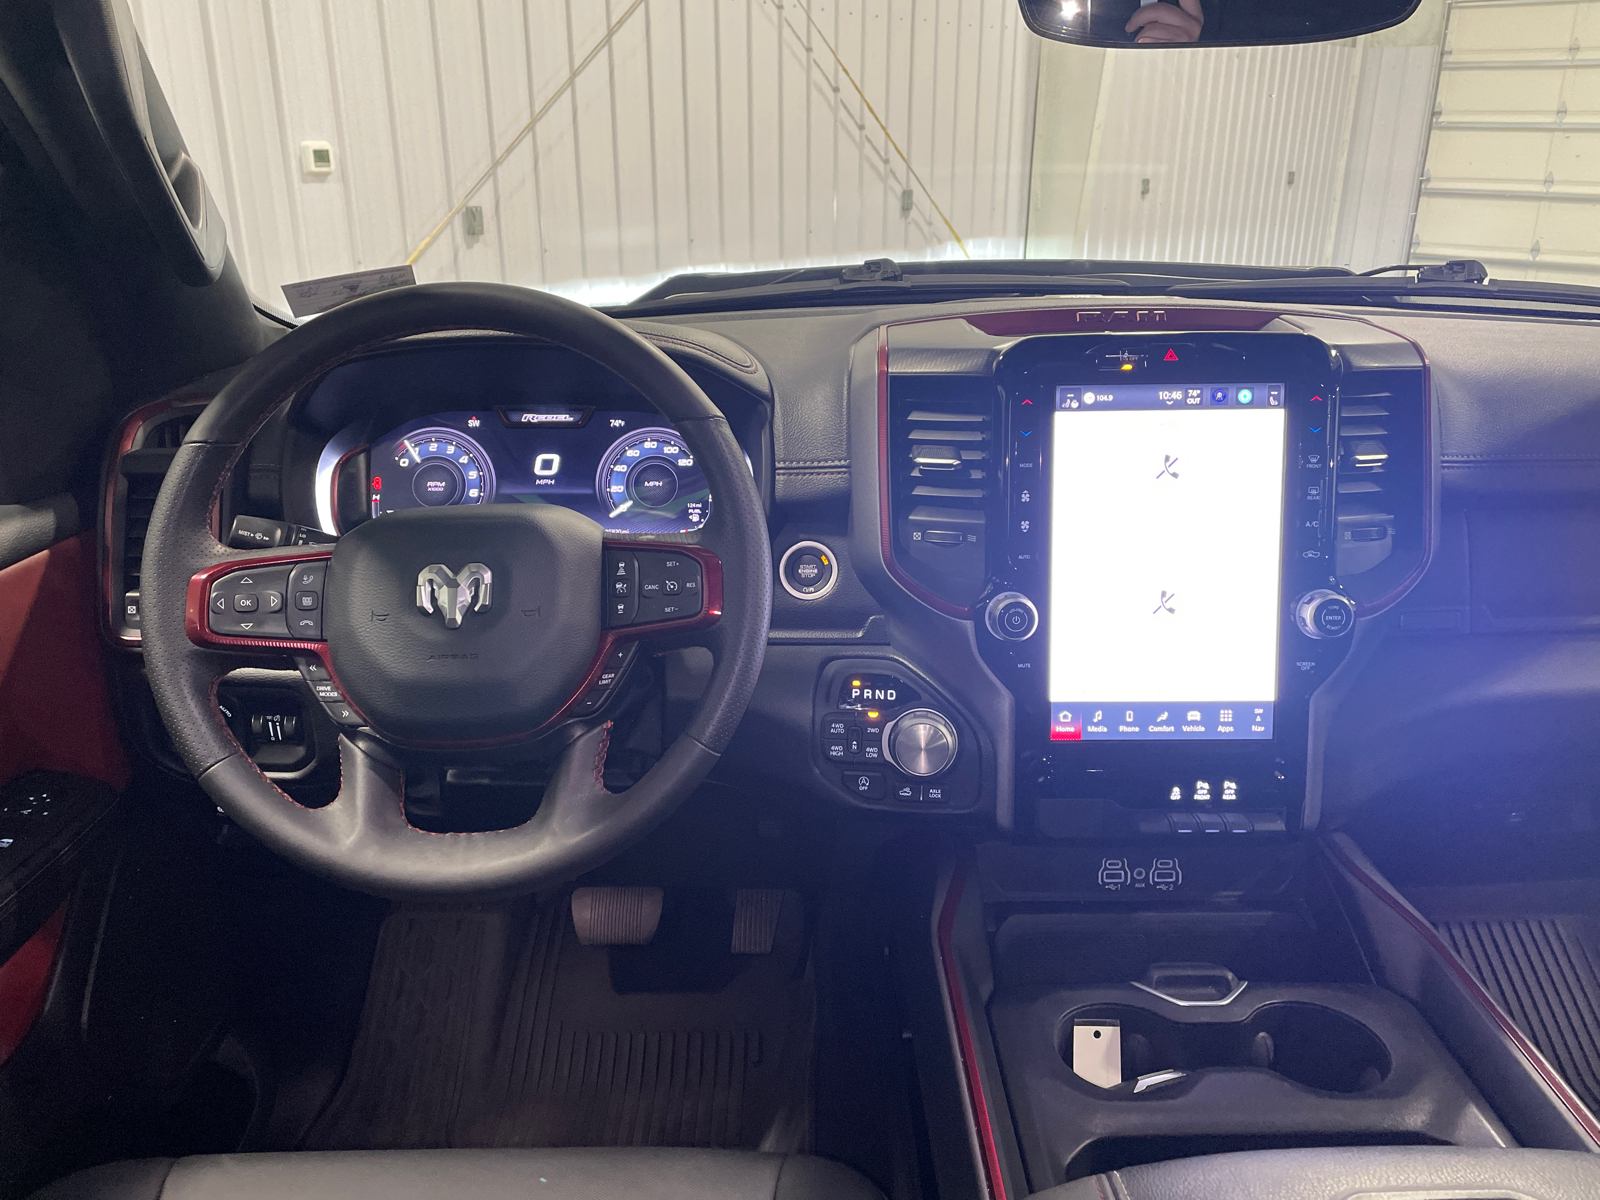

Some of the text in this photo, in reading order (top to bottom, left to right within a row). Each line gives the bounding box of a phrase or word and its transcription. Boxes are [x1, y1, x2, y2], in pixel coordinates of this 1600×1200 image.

[1096, 394, 1113, 402] 104.9
[1158, 390, 1183, 400] 10:46
[1186, 397, 1201, 405] OUT
[467, 419, 480, 427] SW
[428, 443, 438, 452] 2
[643, 441, 658, 449] 80
[446, 445, 455, 454] 3
[626, 449, 640, 457] 60
[663, 446, 679, 454] 100
[399, 458, 409, 467] 0
[458, 455, 468, 464] 4
[677, 458, 694, 466] 120
[533, 453, 561, 476] 0
[613, 464, 627, 472] 40
[468, 470, 478, 480] 5
[468, 488, 479, 497] 6
[610, 485, 624, 493] 20
[240, 599, 252, 607] OK
[426, 653, 479, 662] AIRBAG
[219, 705, 232, 718] AUTO
[1055, 725, 1076, 733] Home
[1087, 725, 1108, 733] Media
[1119, 725, 1140, 733] Phone
[1148, 725, 1175, 733] Comfort
[1182, 724, 1206, 733] Vehicle
[1217, 725, 1234, 734] Apps
